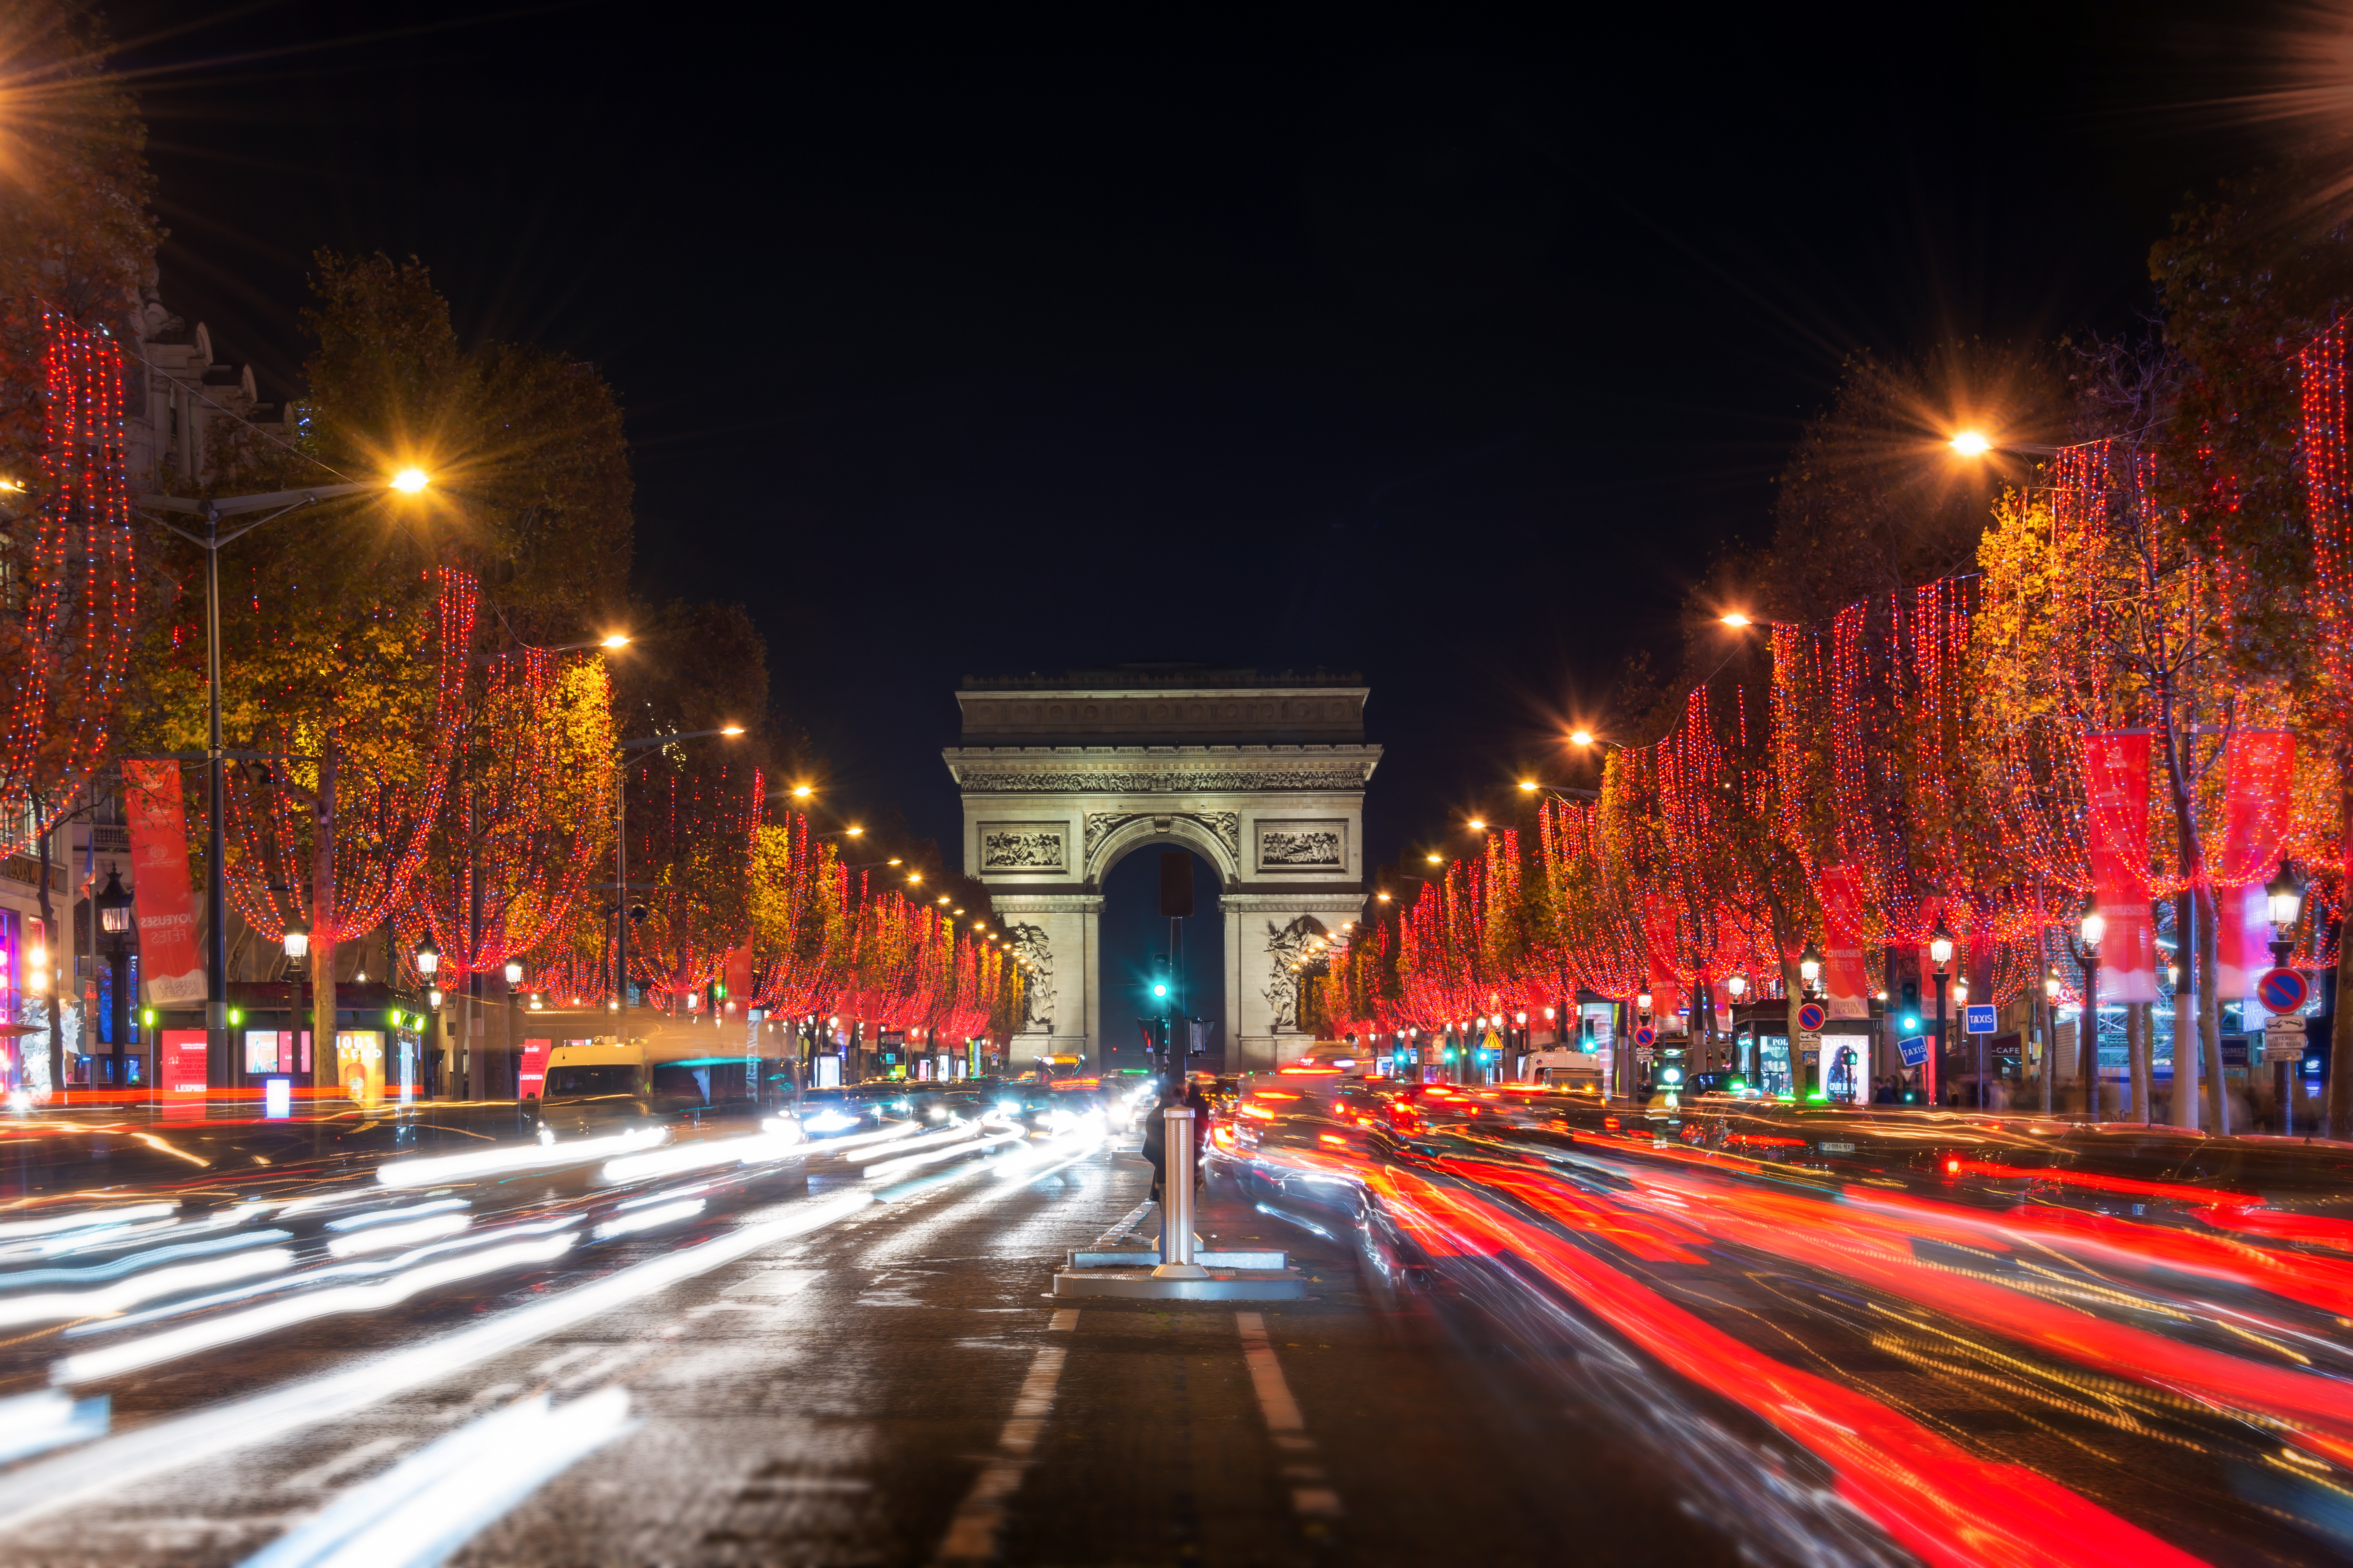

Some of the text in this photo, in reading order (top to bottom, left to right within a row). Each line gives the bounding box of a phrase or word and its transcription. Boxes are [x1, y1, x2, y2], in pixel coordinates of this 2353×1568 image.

[1830, 959, 1857, 971] FÊTES
[1969, 1015, 1993, 1024] TAXIS
[336, 1036, 377, 1049] 100%
[1822, 1038, 1867, 1051] DIVAS
[340, 1049, 382, 1059] LEND
[1903, 1045, 1926, 1057] TAXIS
